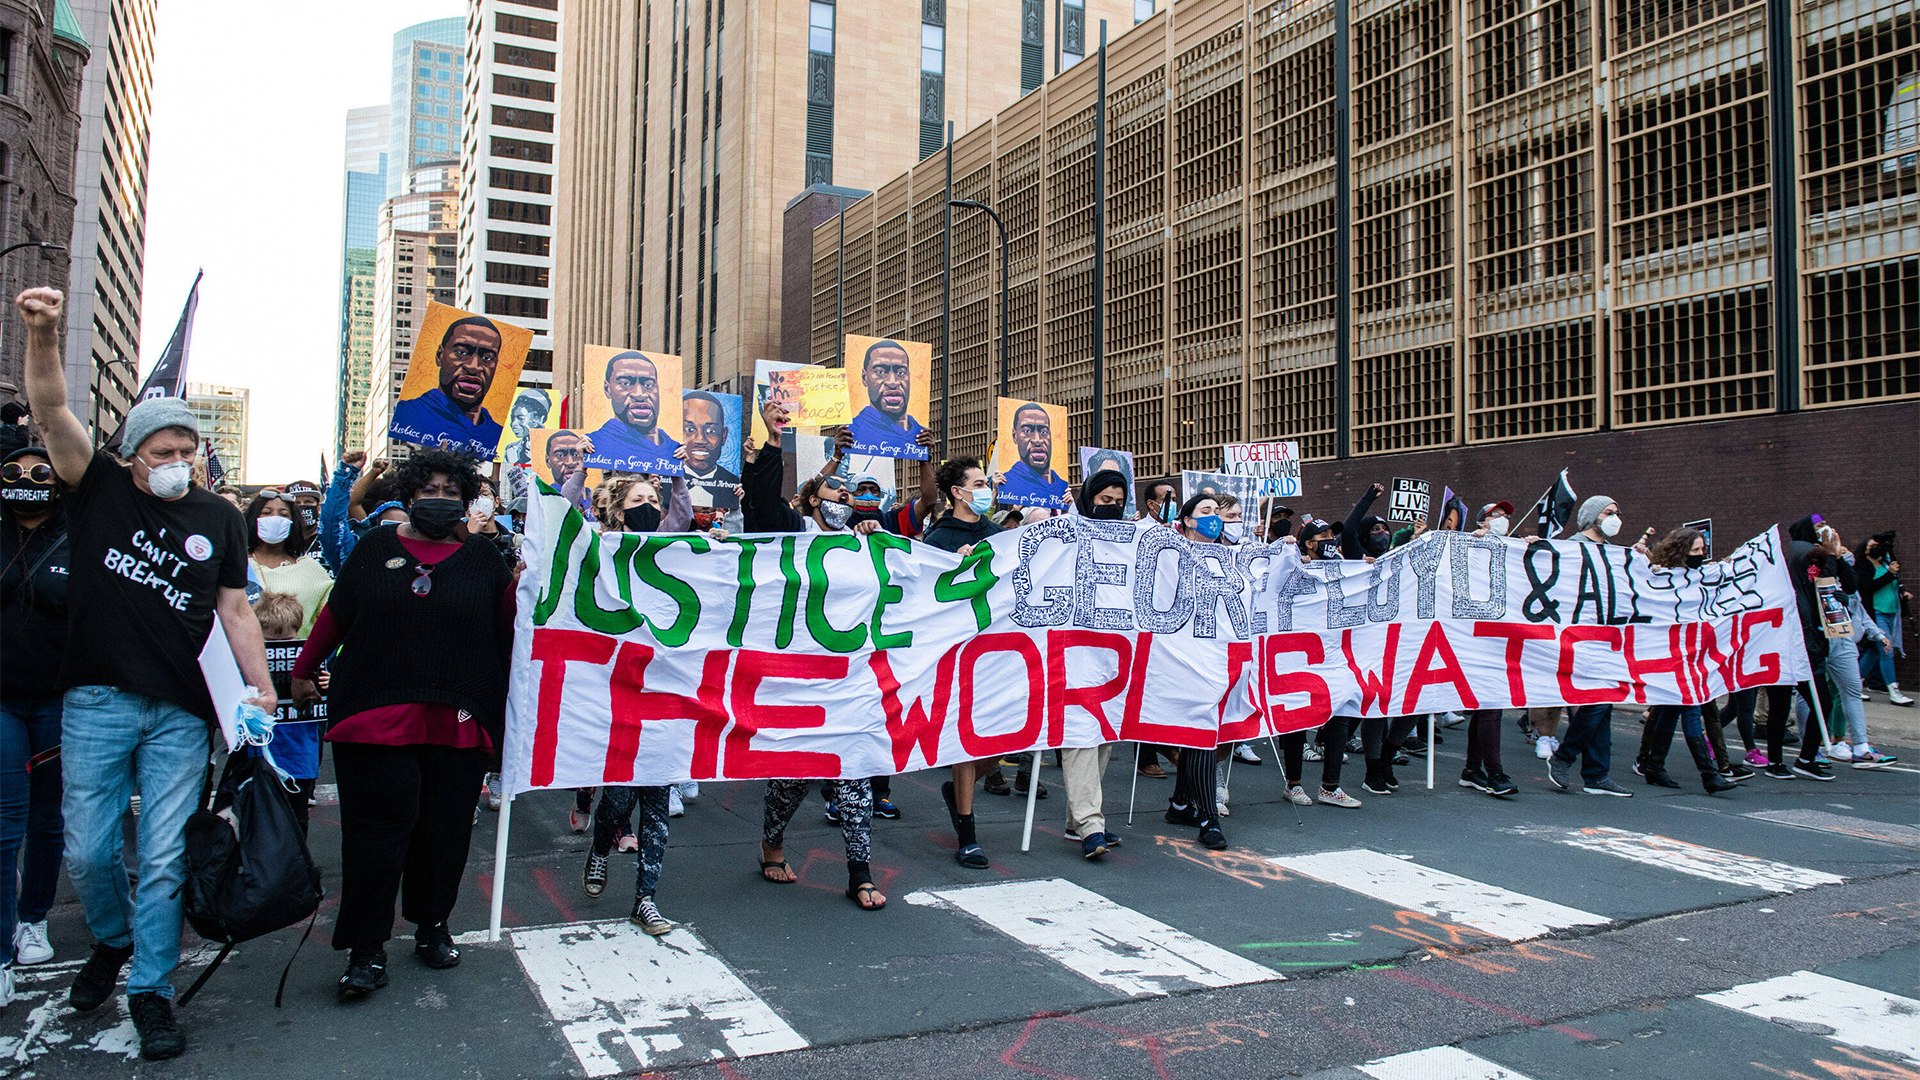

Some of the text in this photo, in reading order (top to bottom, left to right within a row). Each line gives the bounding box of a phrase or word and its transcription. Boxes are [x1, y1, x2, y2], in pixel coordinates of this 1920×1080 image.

[389, 421, 420, 438] Justice
[420, 433, 435, 444] for
[436, 431, 464, 451] Gorge
[868, 443, 879, 454] for
[880, 440, 902, 456] George
[903, 442, 929, 457] Floyd
[1228, 443, 1291, 462] TOGETHER
[583, 453, 684, 475] Justice for George Floyd
[1269, 459, 1301, 479] CHANGE
[1400, 480, 1429, 493] BLACK
[1029, 492, 1048, 507] George
[1395, 493, 1429, 511] LIVES
[159, 528, 166, 539] I
[132, 530, 189, 578] CAN'T
[532, 474, 913, 653] JUSTICE
[934, 540, 1000, 632] 4
[1522, 540, 1561, 624] &
[1572, 541, 1652, 625] ALL
[530, 607, 1783, 788] THE WORLD IS WATCHING
